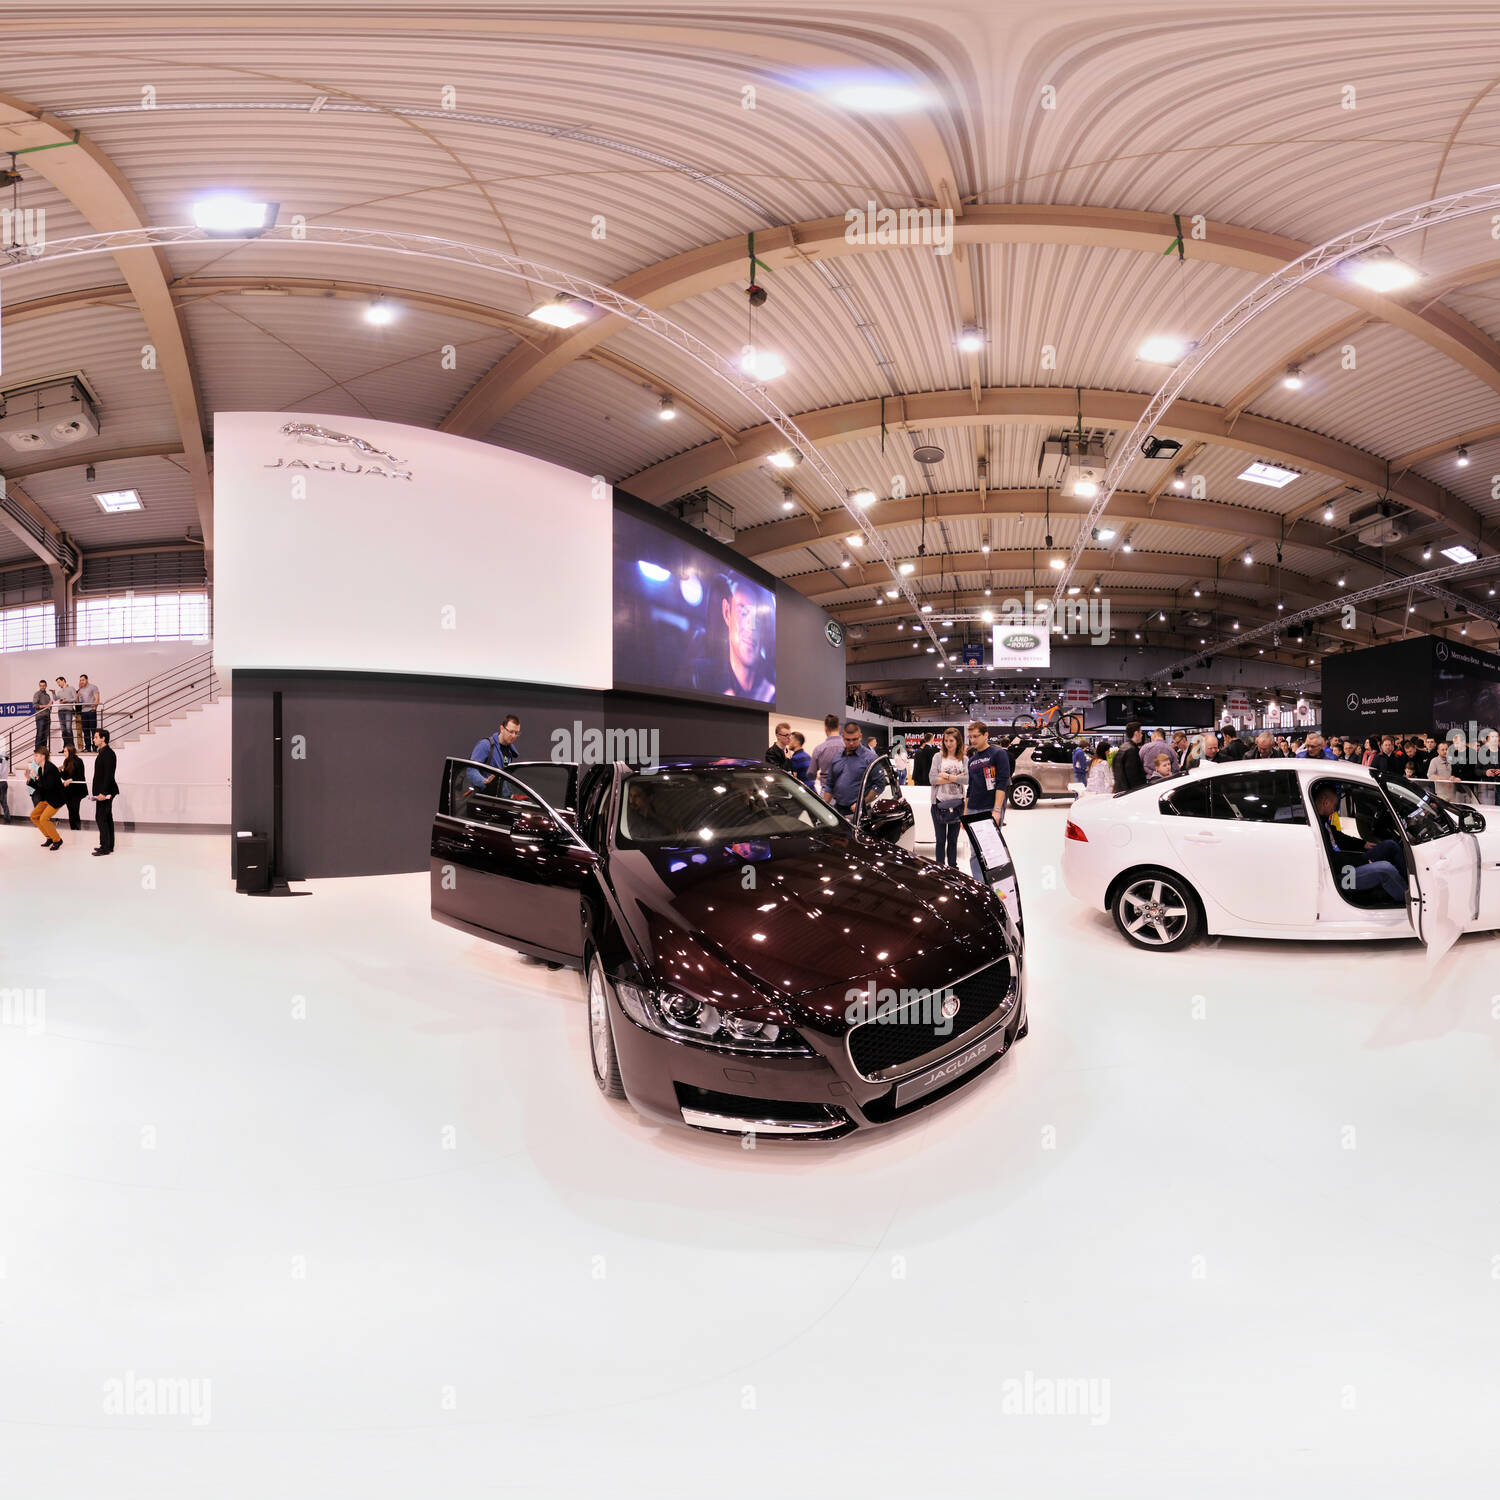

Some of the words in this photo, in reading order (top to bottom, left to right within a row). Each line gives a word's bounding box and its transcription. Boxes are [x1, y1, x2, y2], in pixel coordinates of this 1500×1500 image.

[264, 458, 413, 481] JAGUAR
[1451, 651, 1480, 664] Mercedes-Benz
[1362, 695, 1398, 704] Mercedes-Benz
[6, 705, 16, 714] 10
[924, 1044, 987, 1086] JAGUAR
